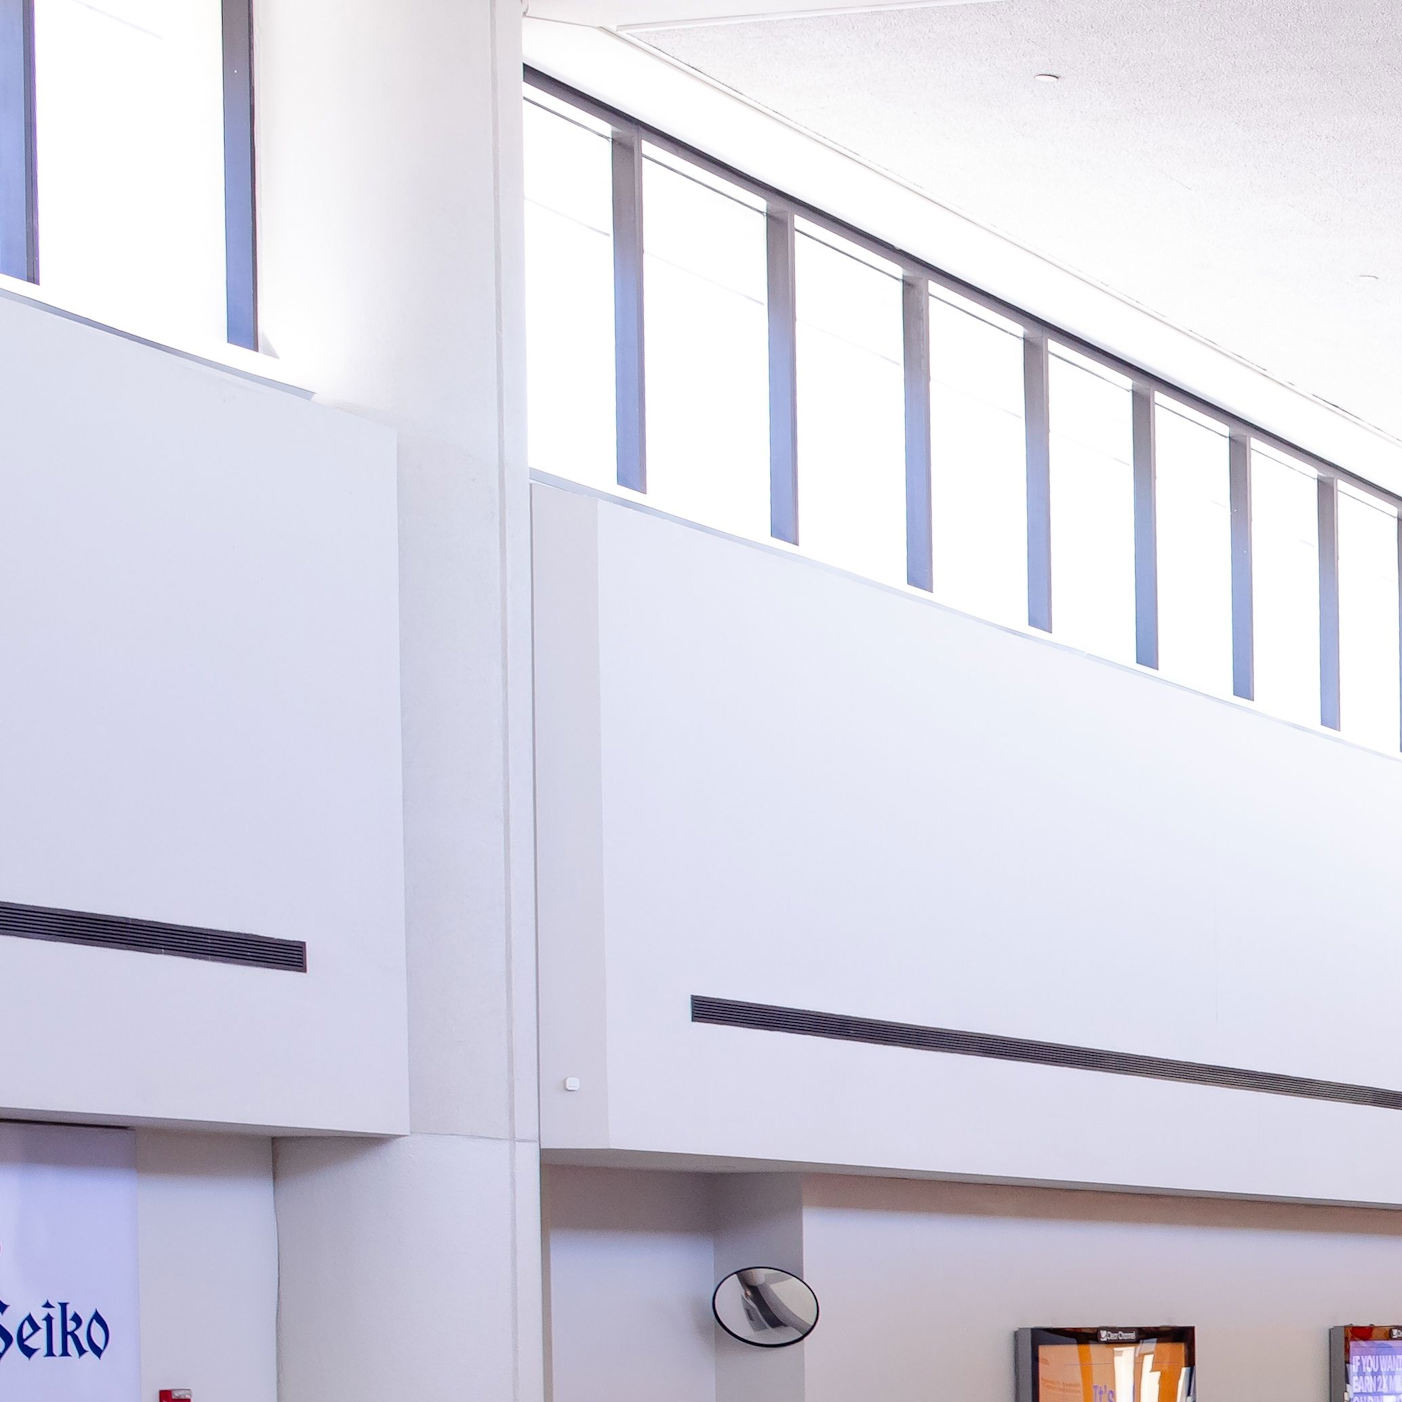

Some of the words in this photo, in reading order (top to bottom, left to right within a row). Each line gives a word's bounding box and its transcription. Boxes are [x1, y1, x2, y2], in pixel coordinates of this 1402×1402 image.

[1353, 1355, 1360, 1372] IF
[1361, 1355, 1378, 1372] YOU
[1377, 1375, 1388, 1392] 2X
